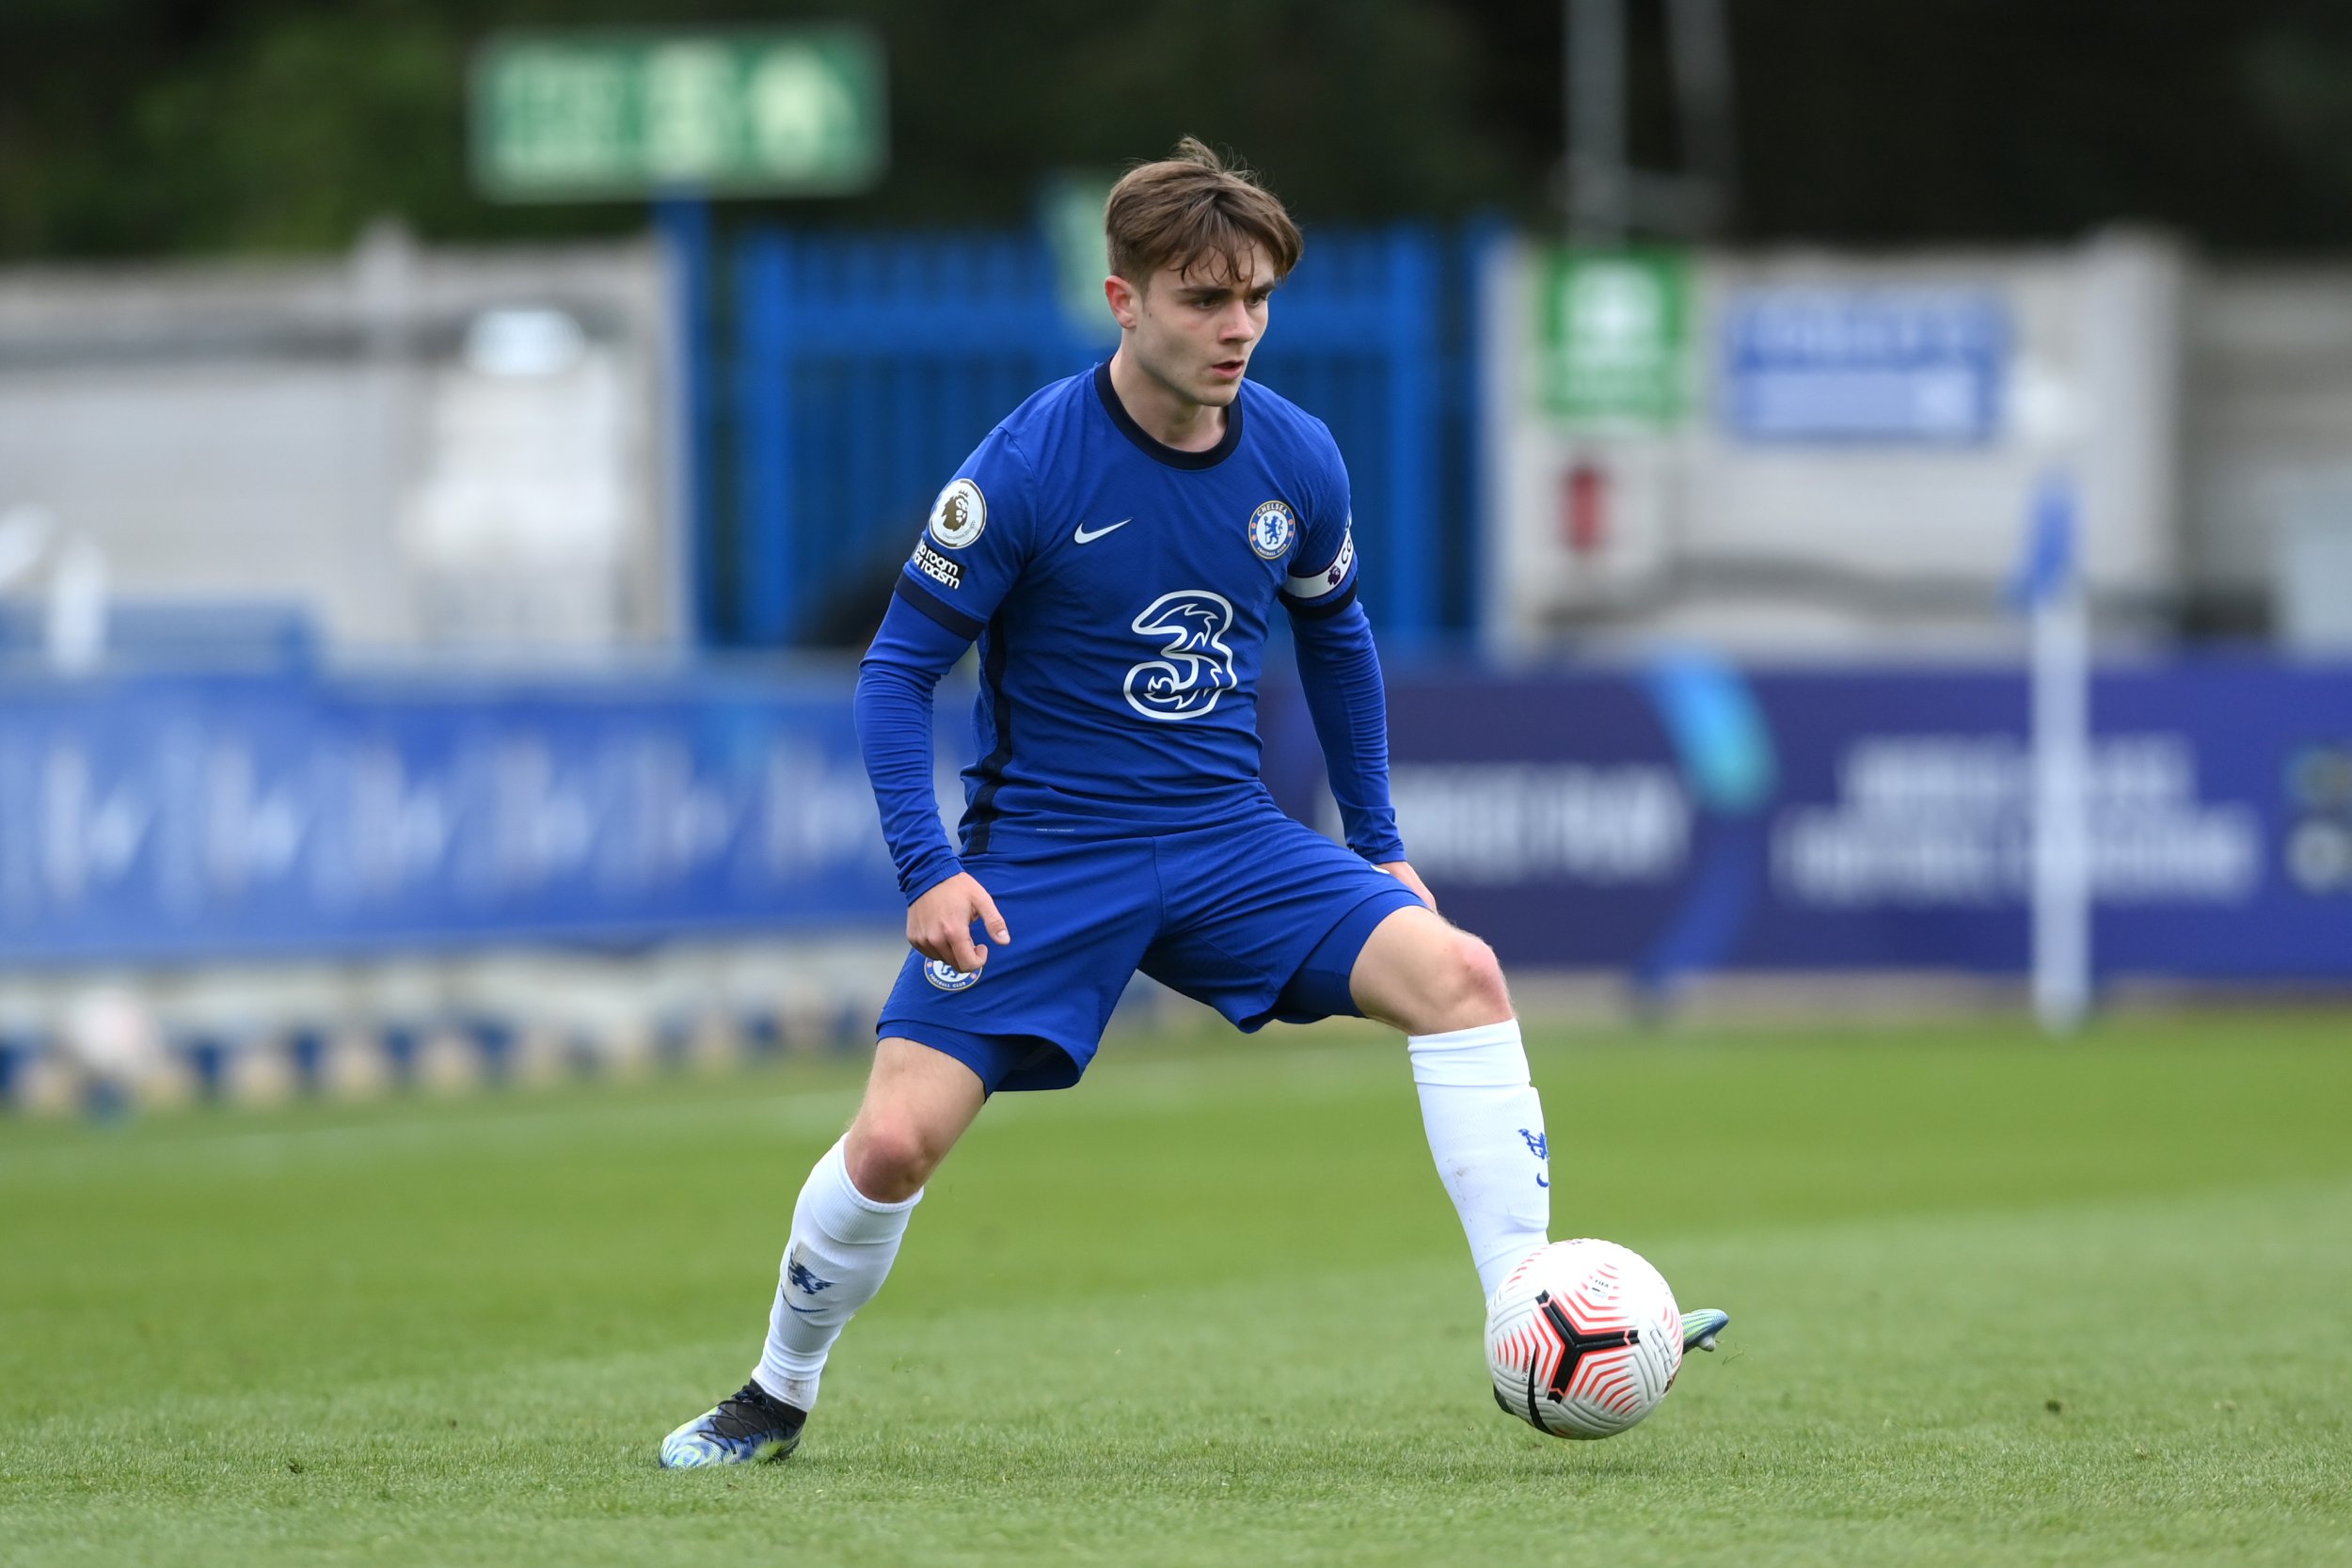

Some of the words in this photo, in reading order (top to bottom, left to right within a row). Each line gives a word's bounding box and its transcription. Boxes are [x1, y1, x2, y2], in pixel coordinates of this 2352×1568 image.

[1257, 503, 1287, 516] CHELSEA
[926, 549, 959, 576] room
[920, 560, 960, 590] racism
[1123, 590, 1237, 720] 3
[930, 974, 950, 988] FOOTBALL
[1595, 1279, 1609, 1289] FIFA
